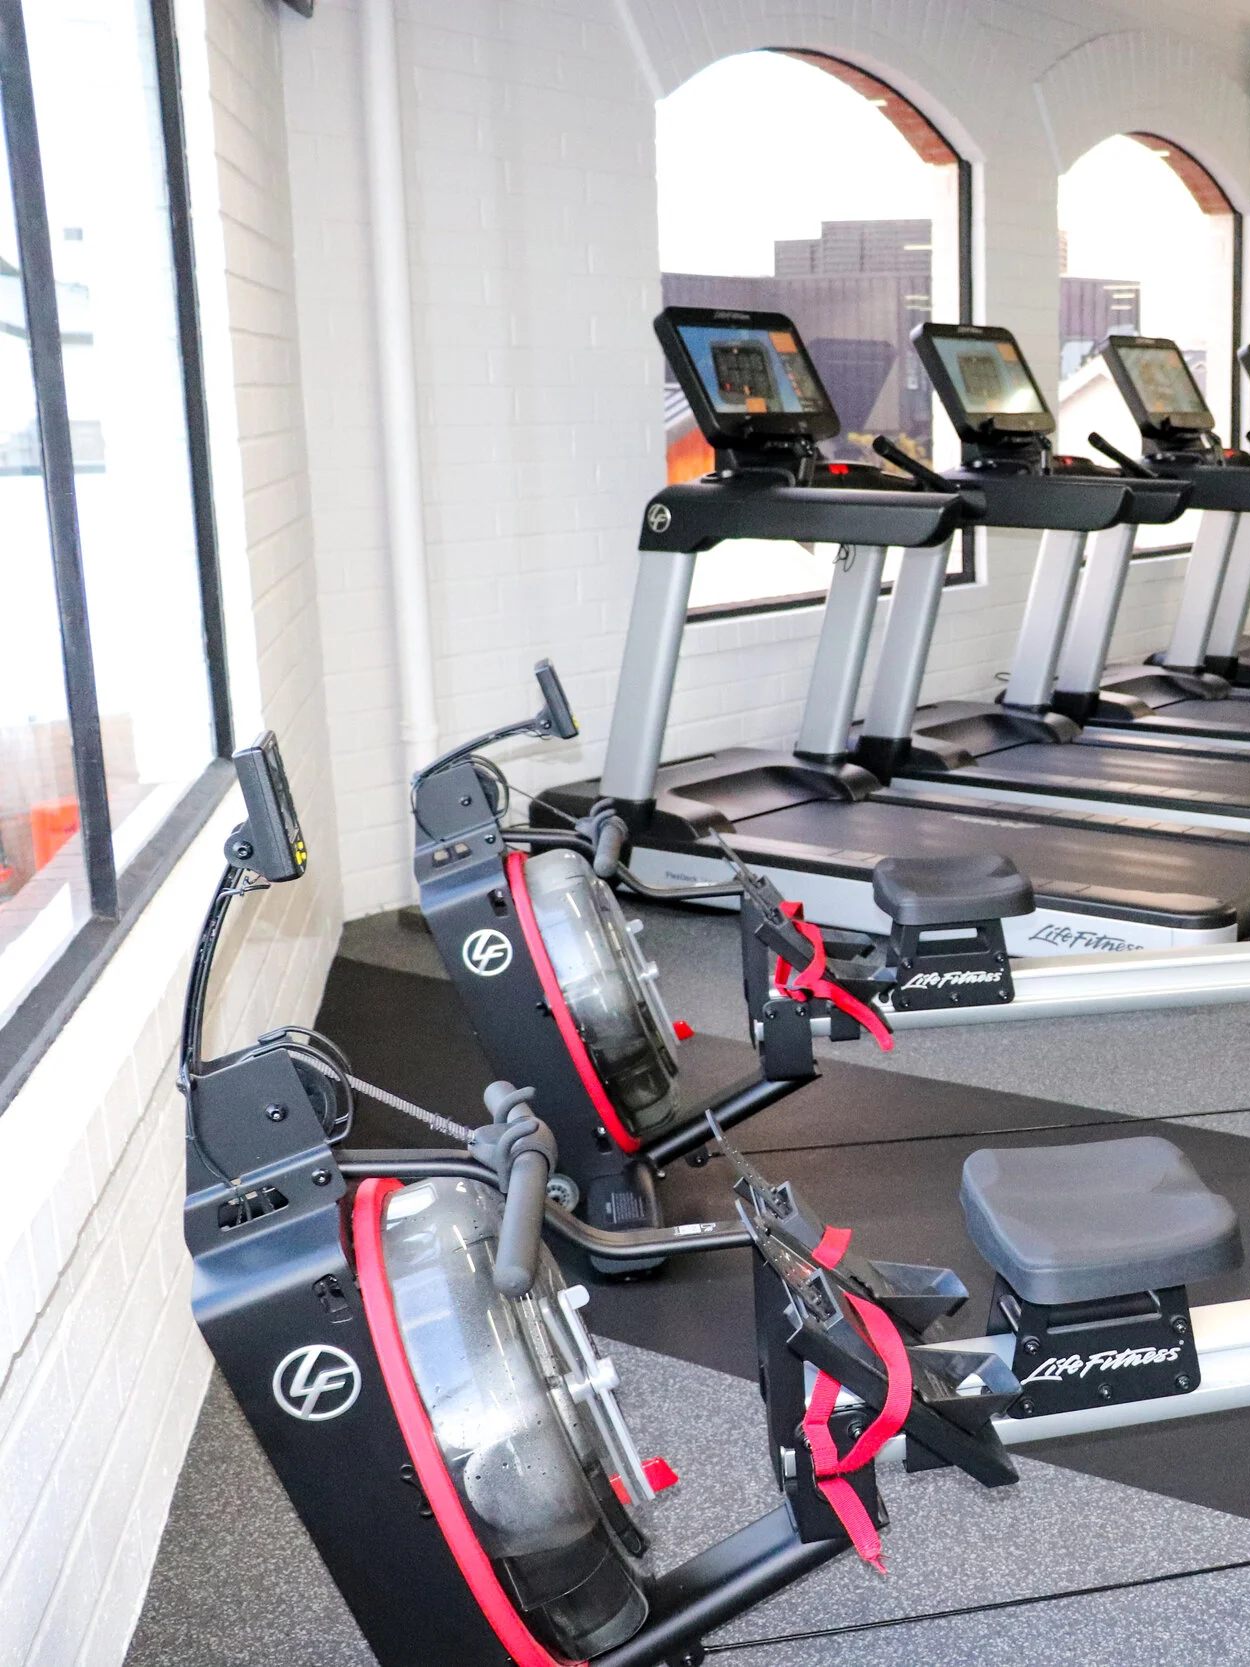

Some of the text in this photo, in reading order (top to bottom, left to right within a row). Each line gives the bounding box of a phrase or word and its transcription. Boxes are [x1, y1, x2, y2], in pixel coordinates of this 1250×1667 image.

[1028, 924, 1072, 946] Life
[901, 970, 1002, 990] Life Fitness
[1020, 1347, 1181, 1386] Life Fitness
